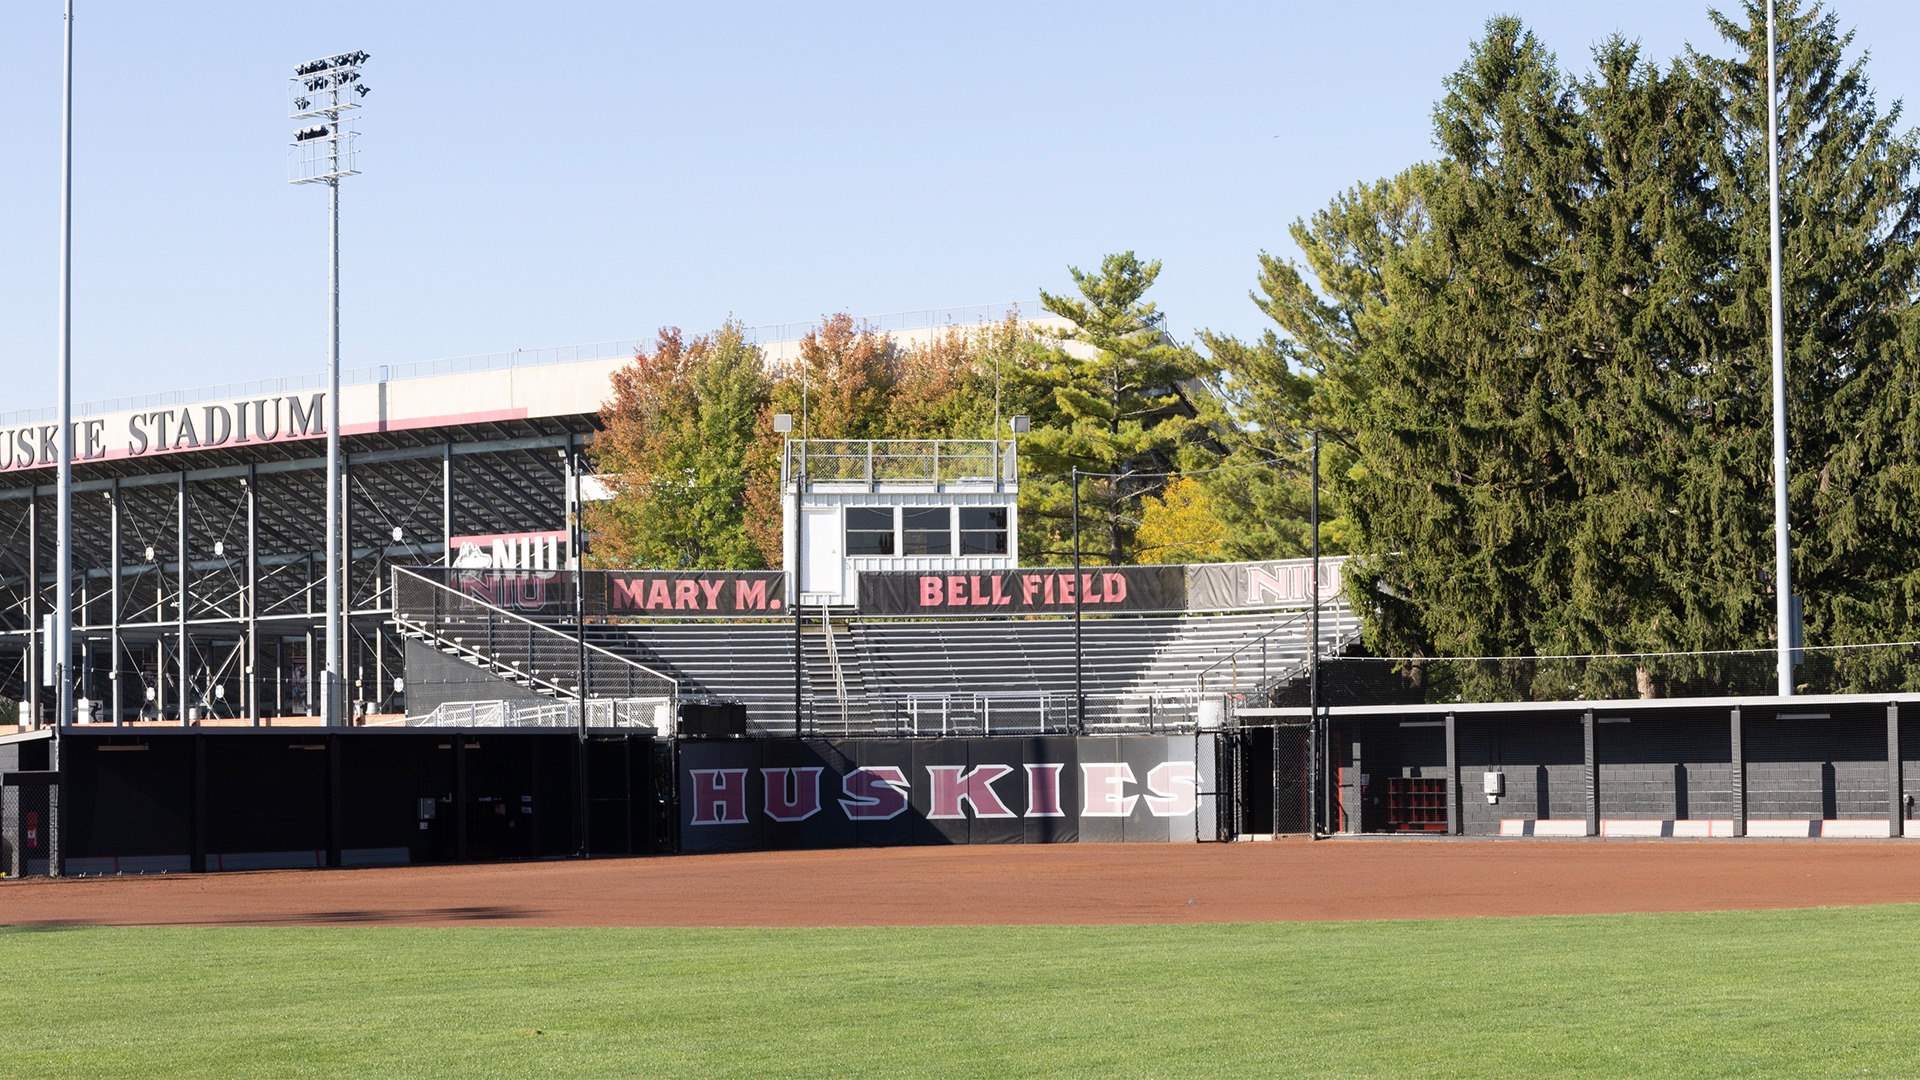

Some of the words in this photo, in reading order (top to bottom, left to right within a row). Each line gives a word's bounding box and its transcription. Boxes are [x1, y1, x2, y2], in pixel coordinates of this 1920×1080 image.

[128, 393, 327, 456] STADIUM
[492, 535, 558, 582] NIU
[459, 573, 547, 611] NIU
[613, 578, 725, 610] MARY
[735, 579, 781, 610] M.
[919, 575, 1011, 606] BELL
[1022, 572, 1127, 605] FIELD
[1246, 561, 1343, 604] NIU
[689, 761, 1204, 825] HUSKIES
